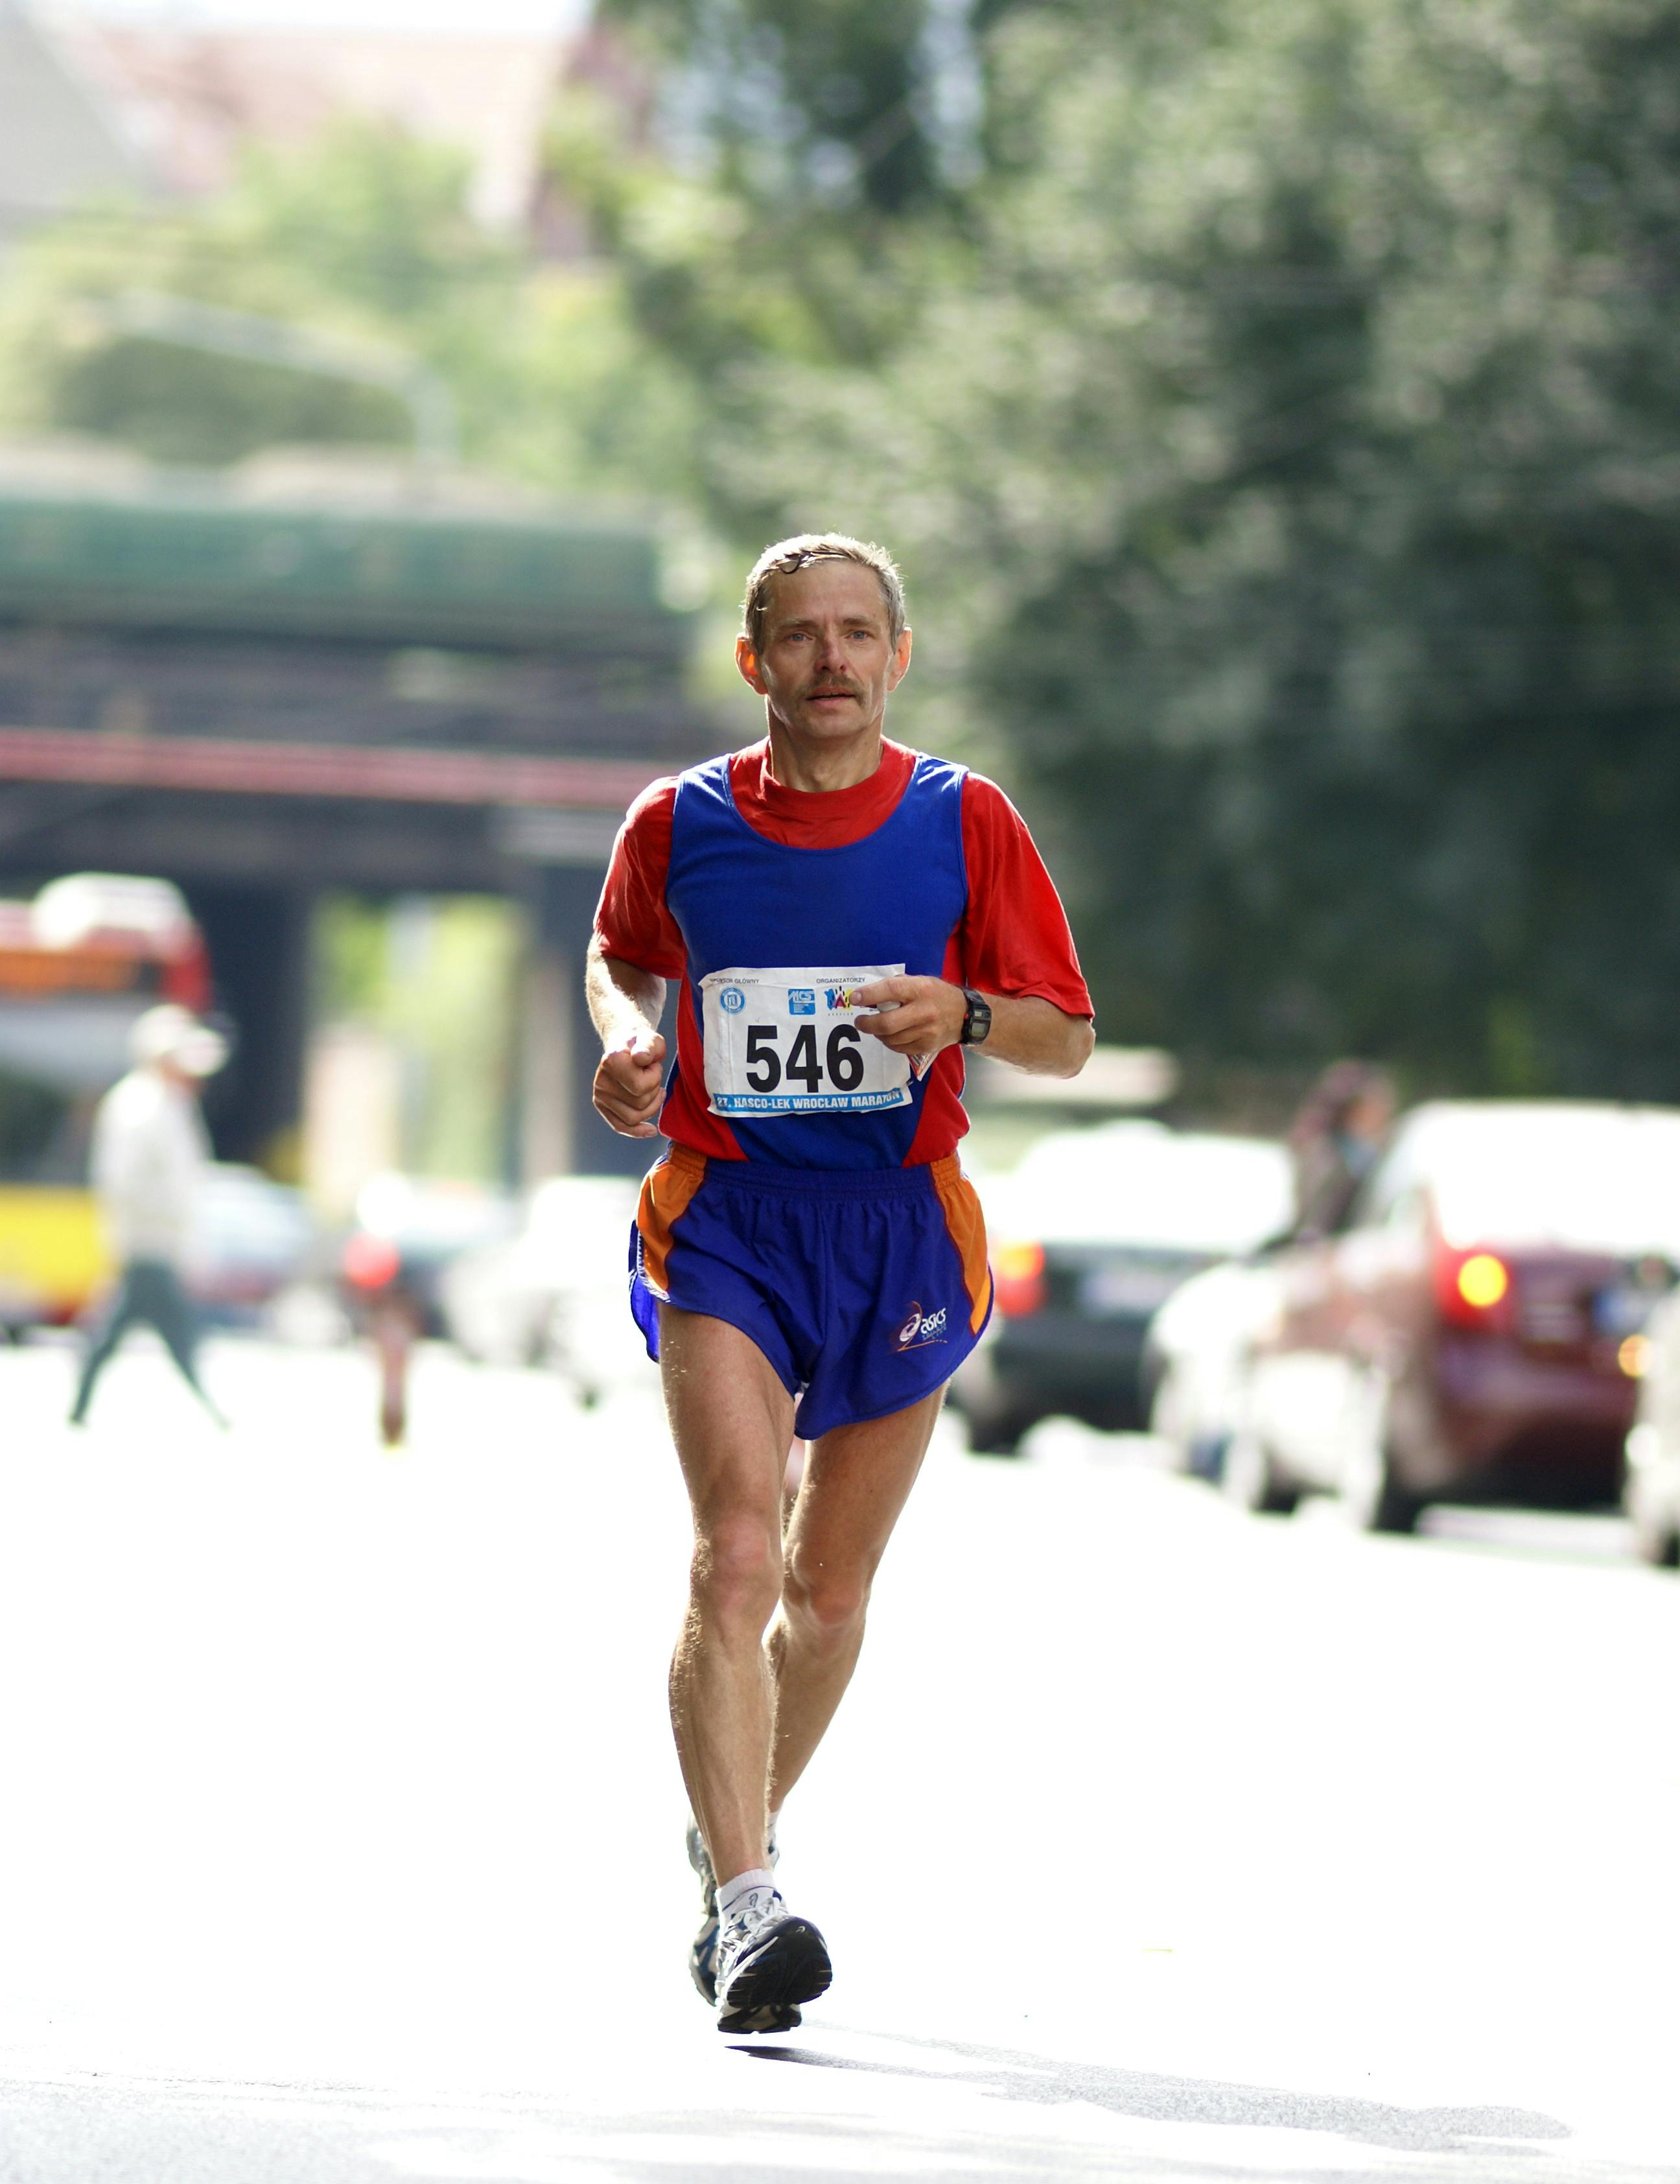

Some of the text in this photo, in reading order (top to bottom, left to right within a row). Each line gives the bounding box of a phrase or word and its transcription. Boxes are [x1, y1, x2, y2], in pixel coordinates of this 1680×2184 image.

[746, 1024, 864, 1093] 546
[734, 1098, 790, 1109] HASCO-LEK
[793, 1098, 848, 1109] WROCŁAW
[851, 1091, 900, 1107] MARATON
